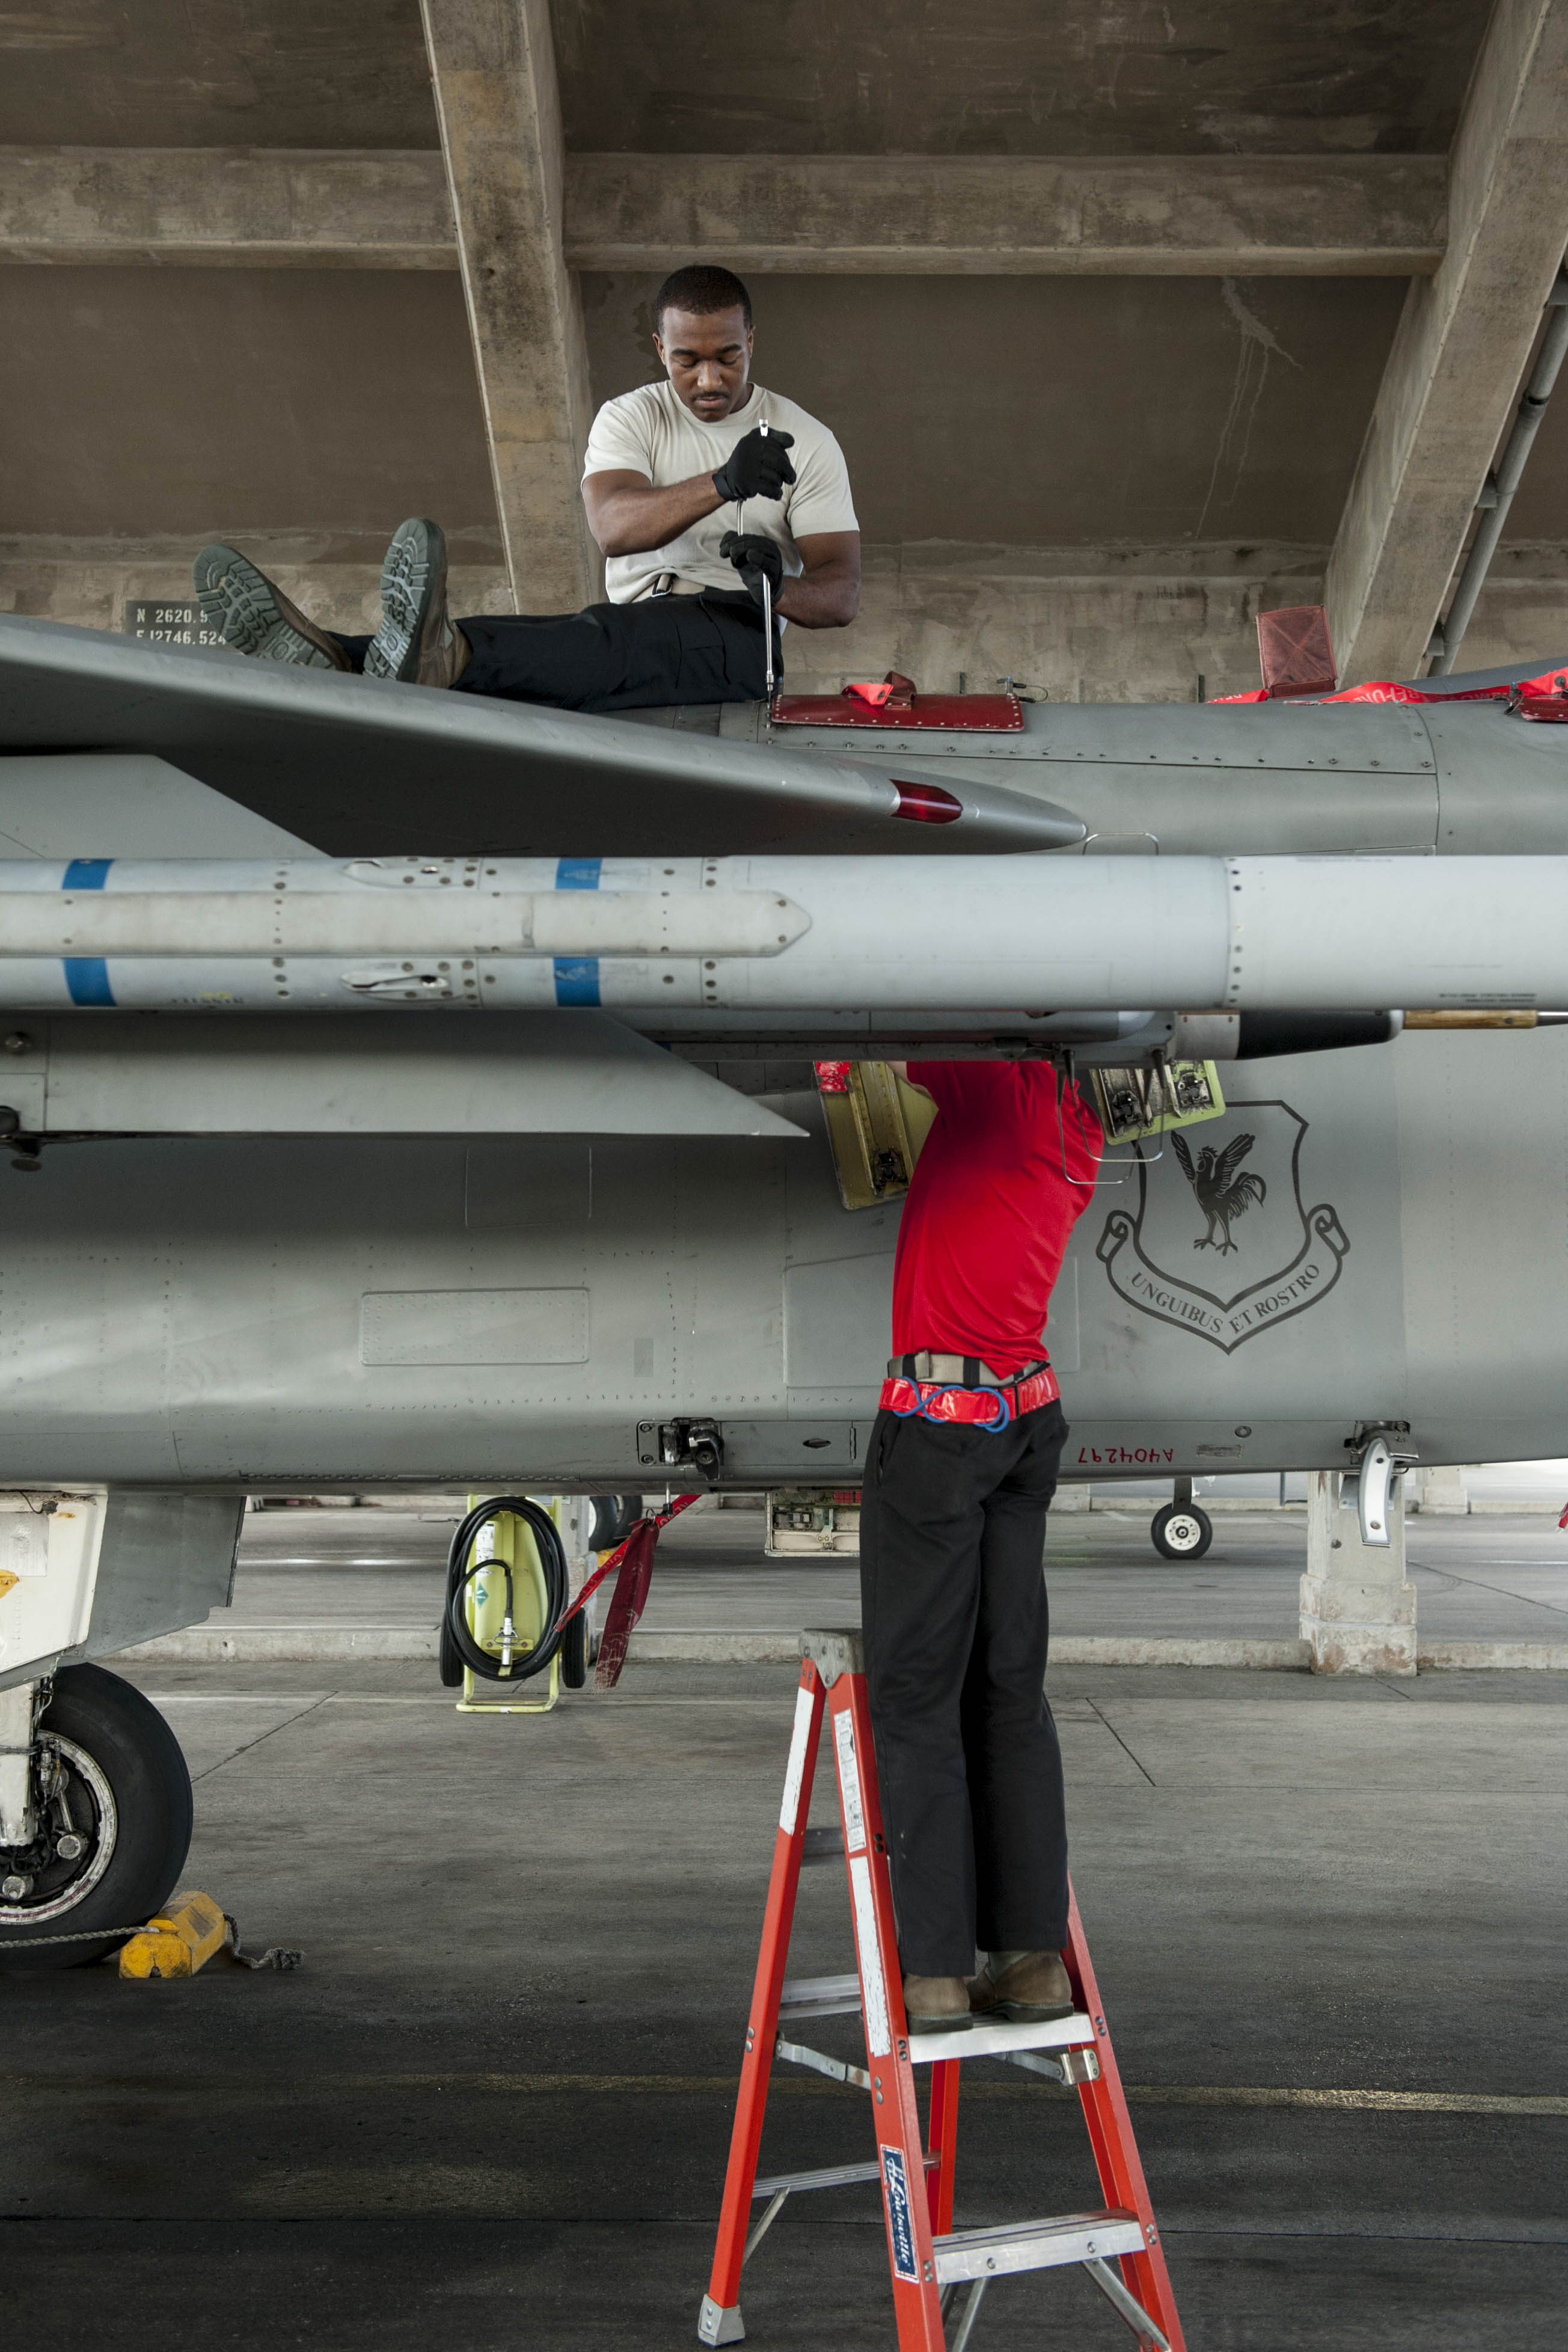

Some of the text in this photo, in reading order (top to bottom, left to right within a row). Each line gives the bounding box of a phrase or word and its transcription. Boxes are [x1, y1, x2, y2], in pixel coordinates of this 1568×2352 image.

[136, 608, 145, 623] N
[1130, 1264, 1320, 1334] UNGUIBUS ET ROSTRO
[889, 2175, 909, 2264] Louisville
